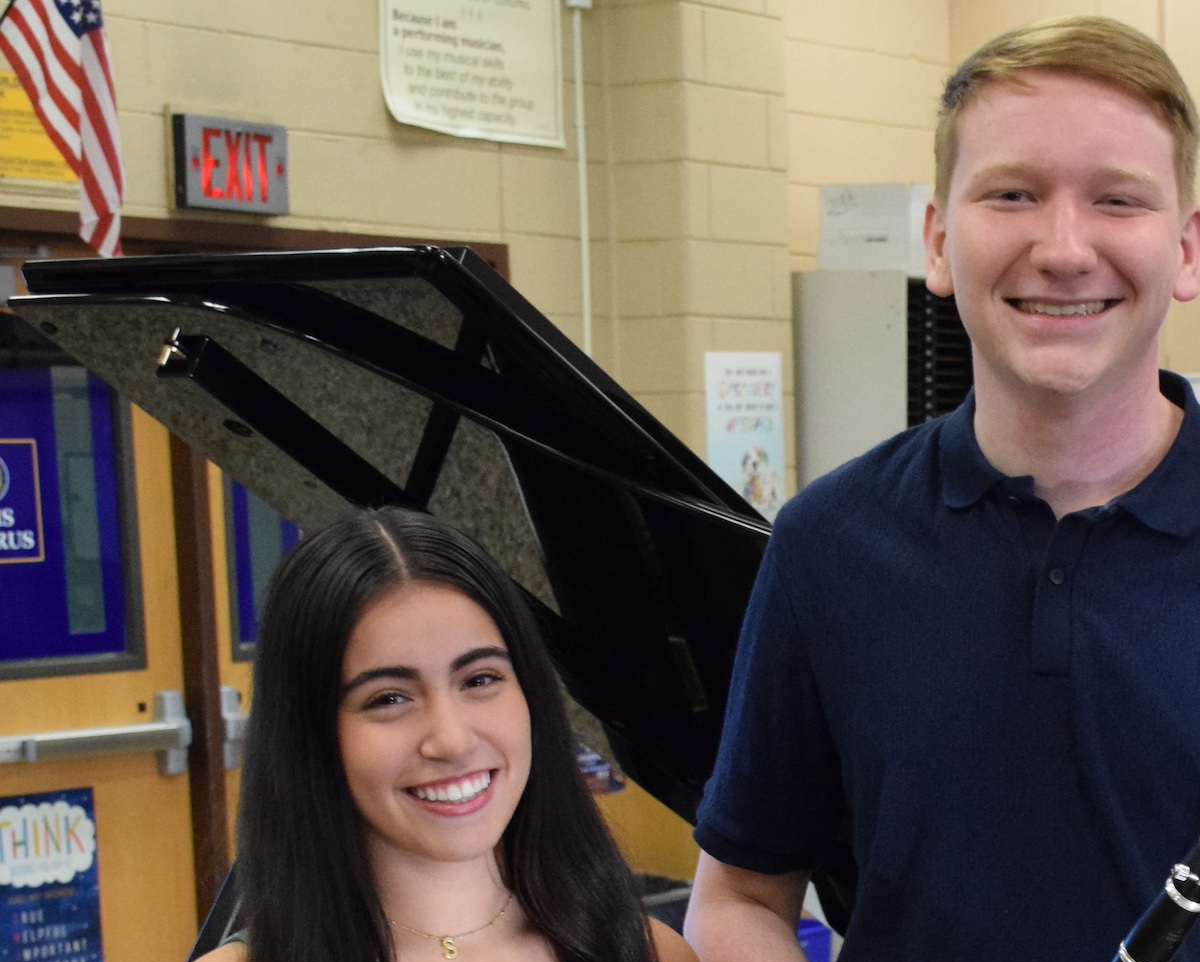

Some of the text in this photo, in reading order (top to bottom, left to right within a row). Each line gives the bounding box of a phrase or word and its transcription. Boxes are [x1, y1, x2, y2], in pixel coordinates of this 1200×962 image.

[402, 28, 458, 48] performing
[201, 127, 272, 204] EXIT
[0, 814, 86, 864] THINK
